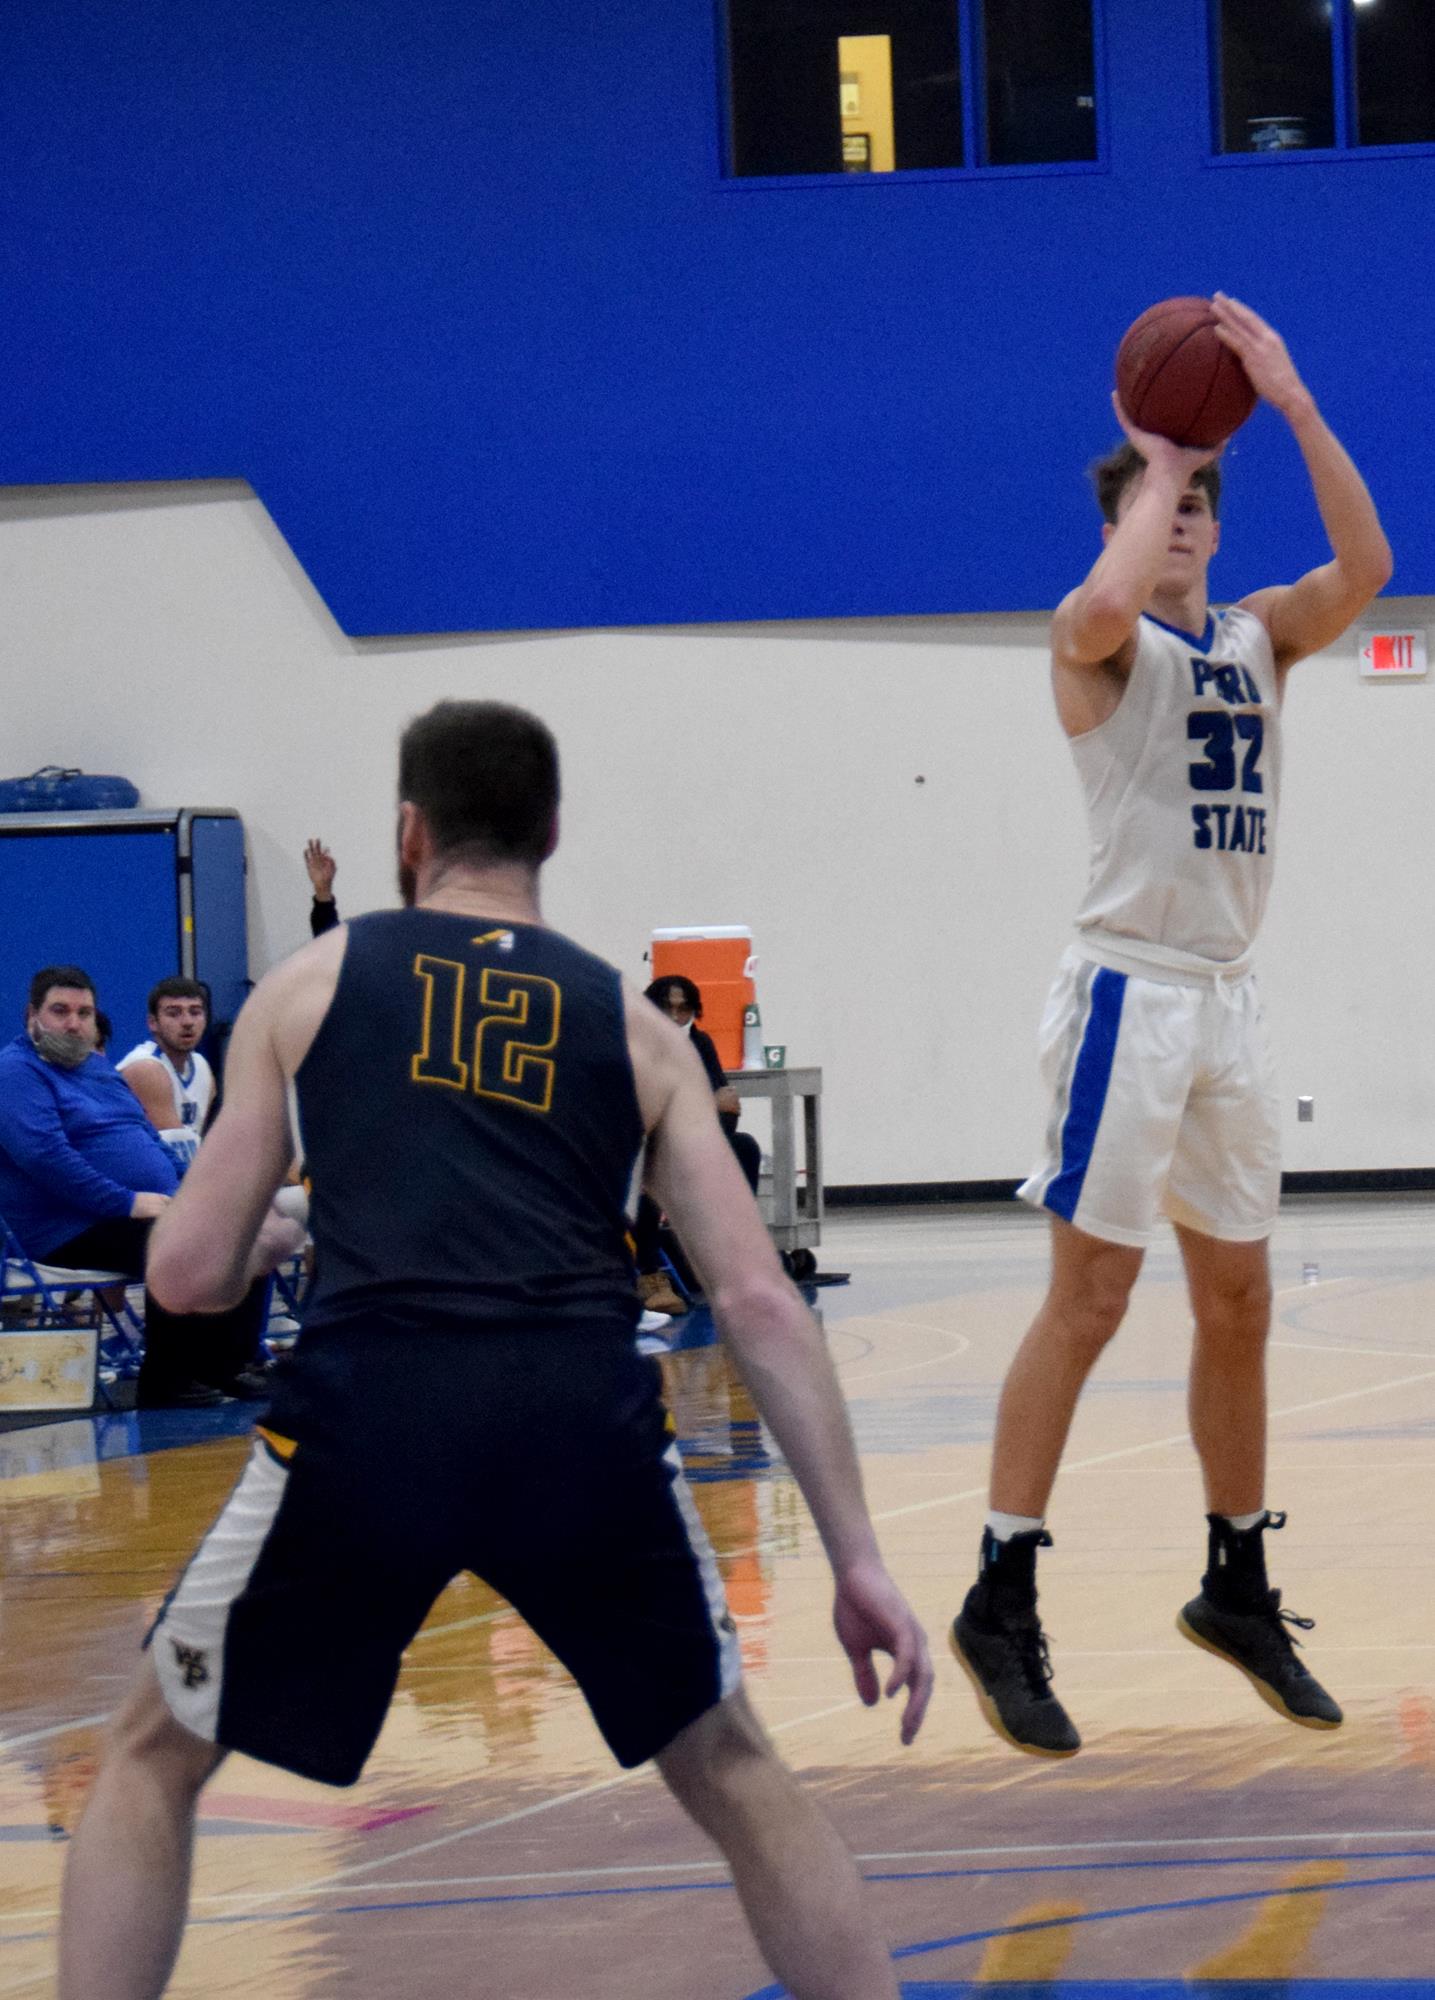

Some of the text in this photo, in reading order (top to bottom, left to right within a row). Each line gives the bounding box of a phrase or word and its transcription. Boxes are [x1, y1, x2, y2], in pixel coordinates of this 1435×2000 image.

[1187, 710, 1265, 793] 32
[1192, 803, 1266, 854] STATE
[411, 953, 561, 1113] 12
